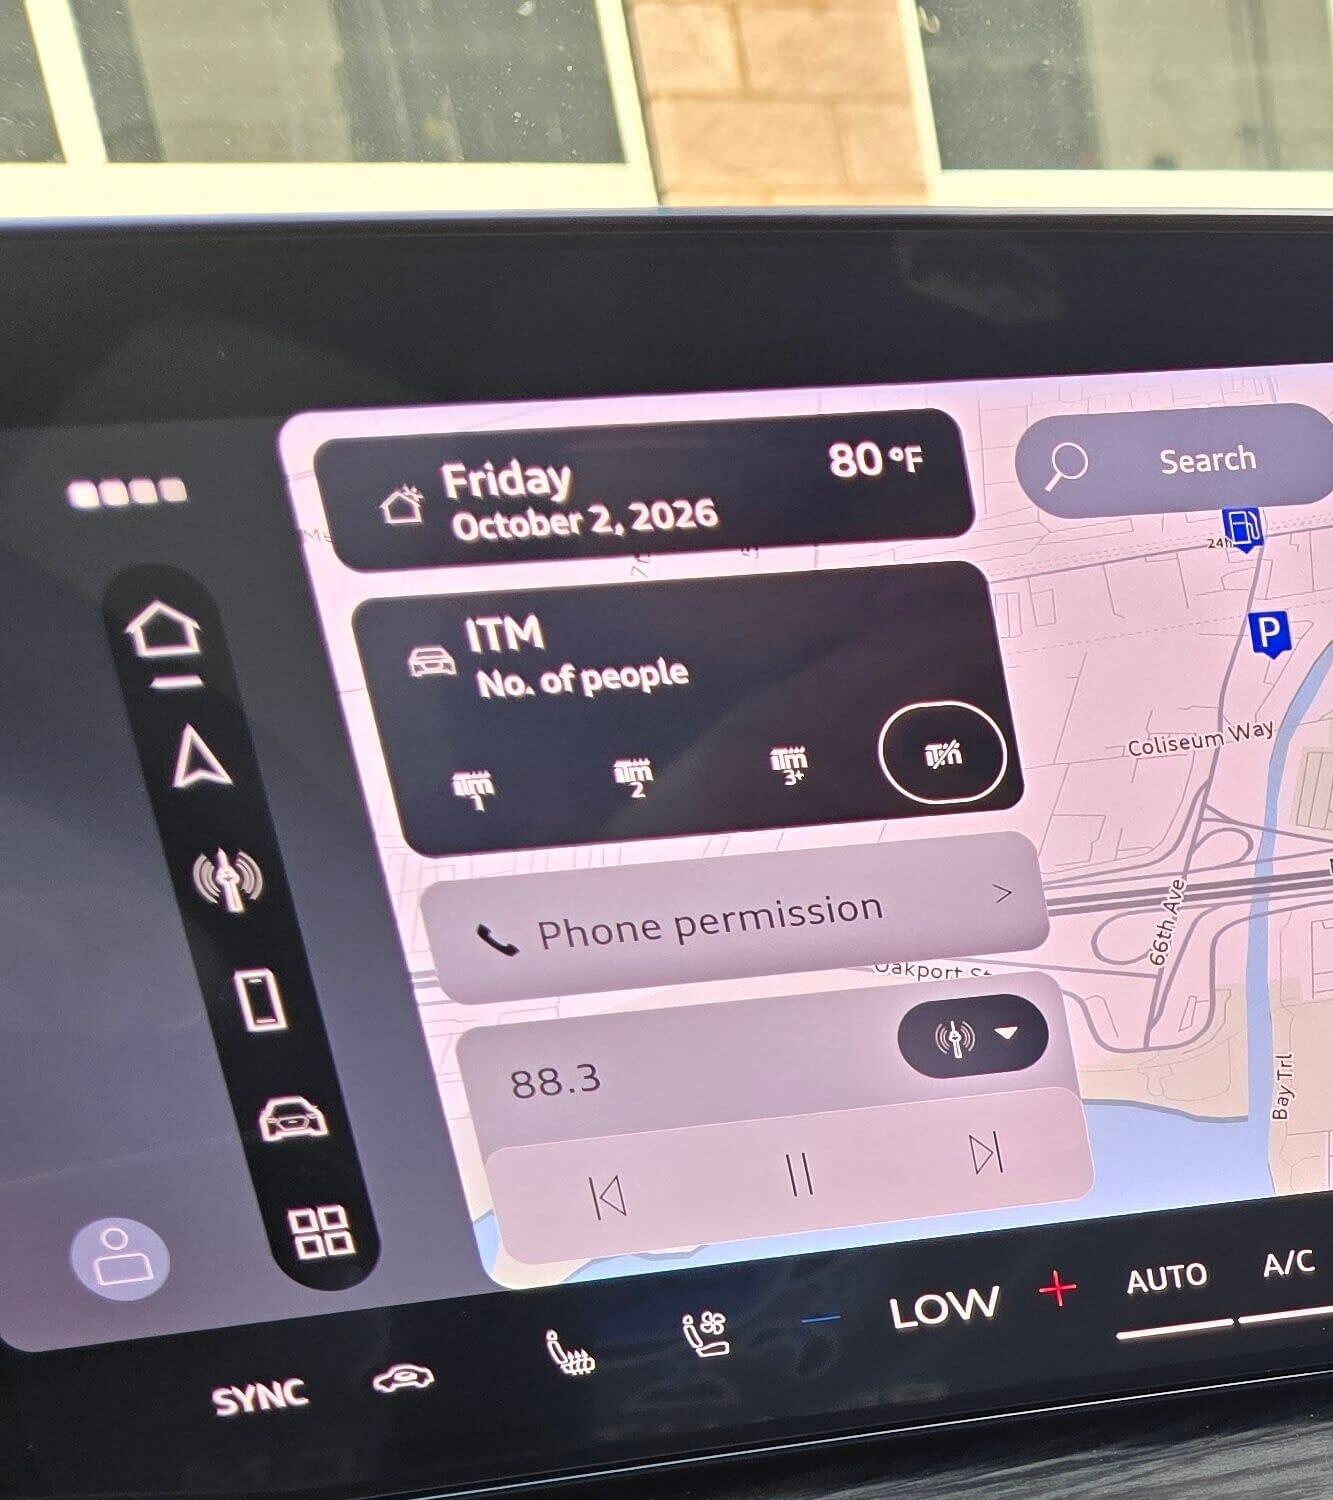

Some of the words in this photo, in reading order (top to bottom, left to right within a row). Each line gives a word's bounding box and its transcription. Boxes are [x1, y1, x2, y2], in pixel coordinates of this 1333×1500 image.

[1160, 445, 1257, 475] Search
[441, 457, 572, 503] Friday
[452, 506, 584, 541] October
[588, 503, 625, 537] 2,
[628, 498, 719, 532] 2026
[465, 612, 545, 654] ITM
[477, 668, 535, 700] No.
[540, 662, 575, 694] of
[580, 656, 690, 699] people
[1129, 729, 1225, 758] Coliseum
[1228, 719, 1275, 741] Way
[538, 910, 662, 950] Phone
[673, 893, 885, 947] permission
[1150, 919, 1175, 966] 66th
[1163, 879, 1185, 916] Ave
[511, 1063, 602, 1100] 88.3
[1275, 1053, 1293, 1081] Trl
[1272, 1084, 1296, 1120] Bay
[1127, 1261, 1208, 1295] AUTO
[1263, 1248, 1316, 1279] A/C
[889, 1284, 1001, 1330] LOW
[212, 1378, 310, 1417] SYNC
